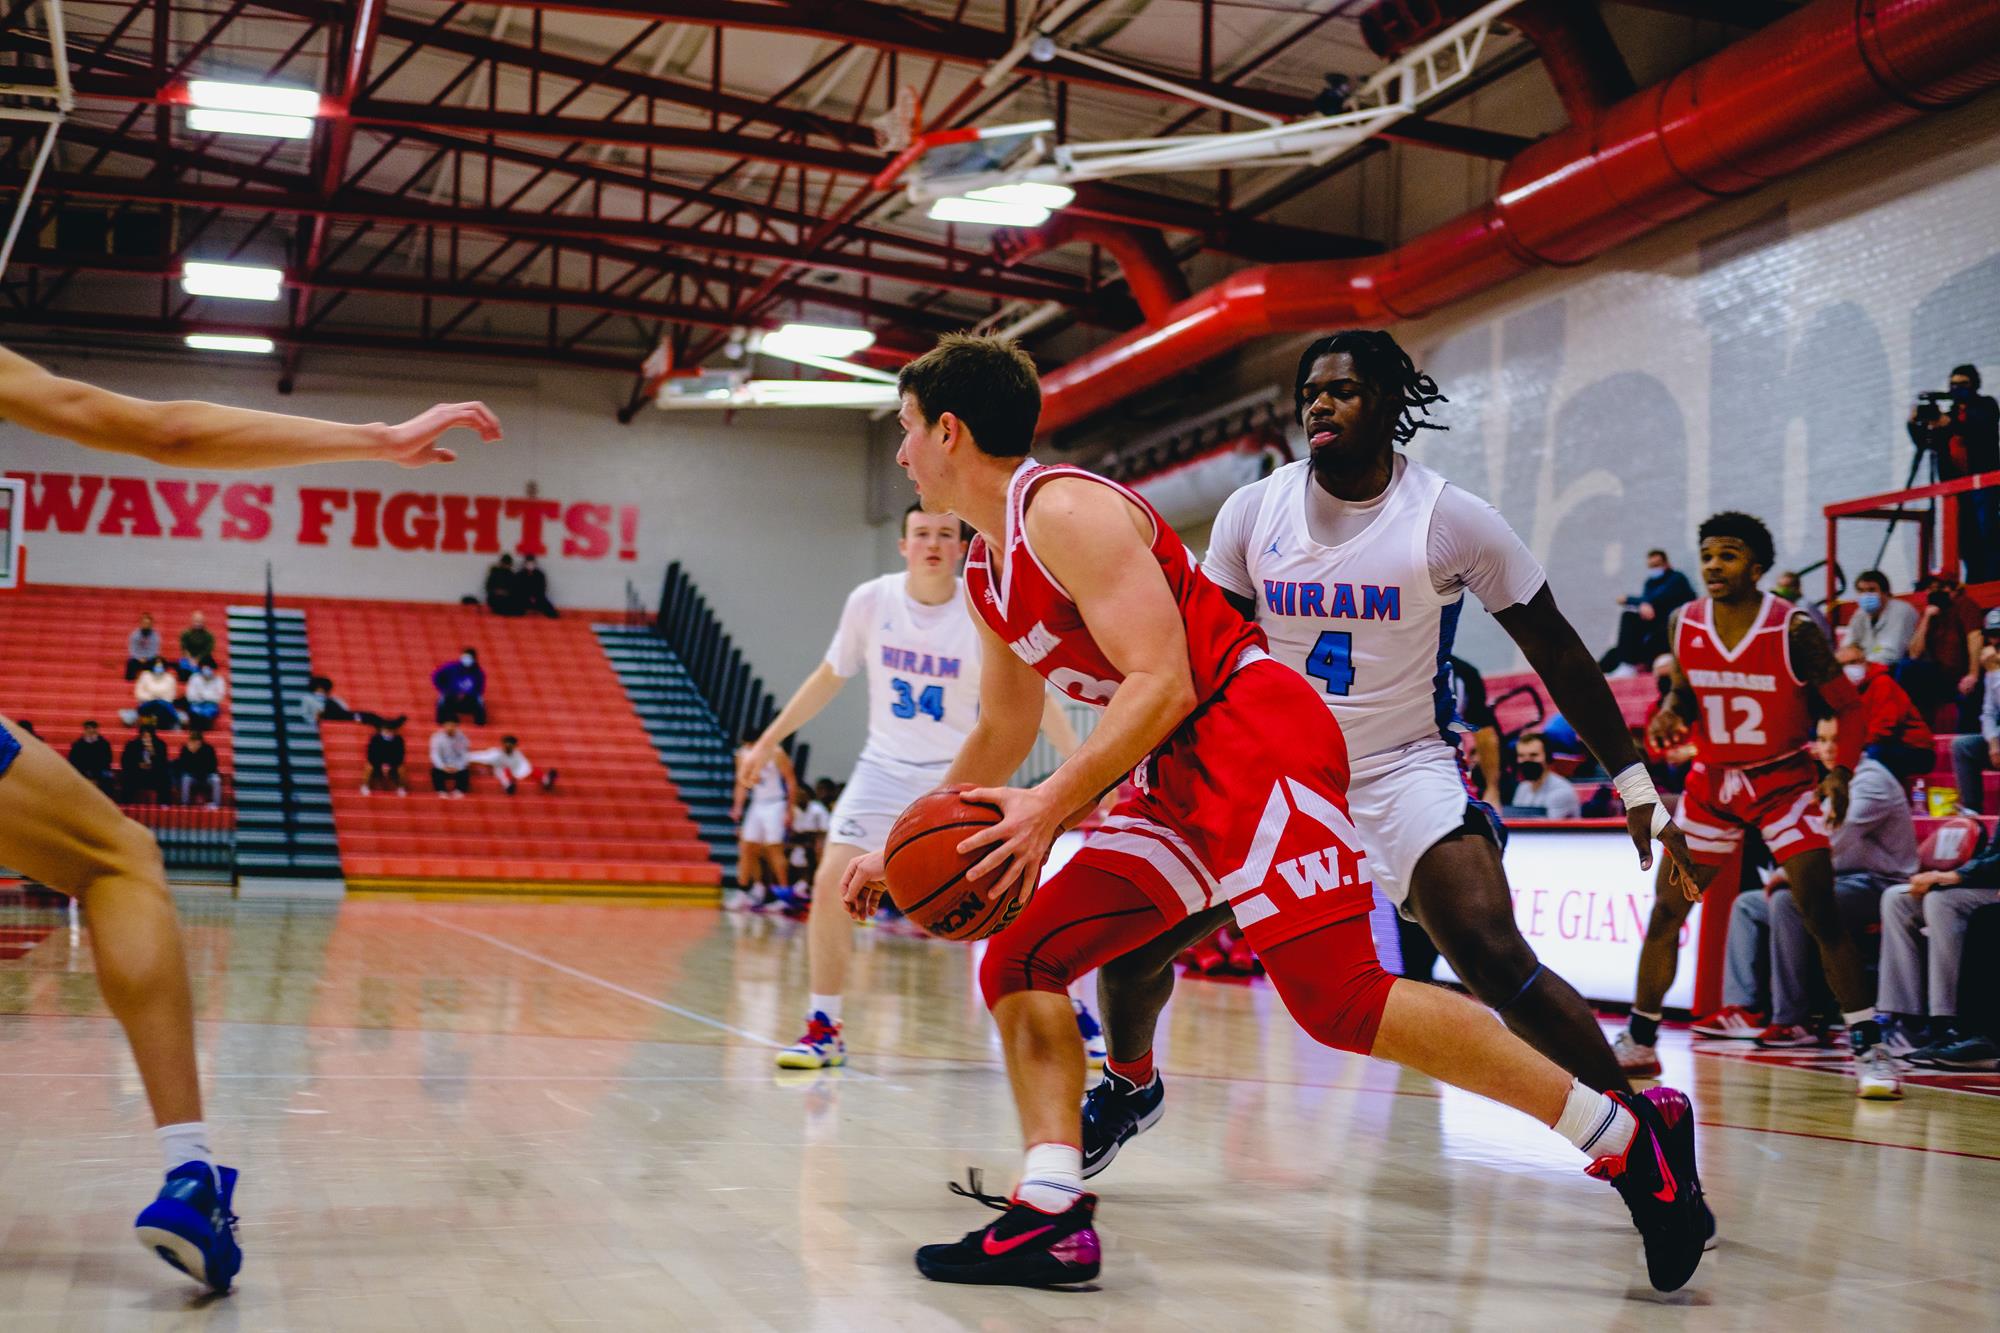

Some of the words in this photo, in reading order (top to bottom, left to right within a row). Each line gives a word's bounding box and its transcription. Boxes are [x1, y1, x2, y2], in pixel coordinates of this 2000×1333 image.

[297, 487, 638, 562] FIGHTS!
[1263, 579, 1401, 622] HIRAM
[881, 645, 960, 679] HIRAM
[1305, 630, 1356, 696] 4
[891, 677, 944, 722] 34
[1703, 695, 1767, 745] 12
